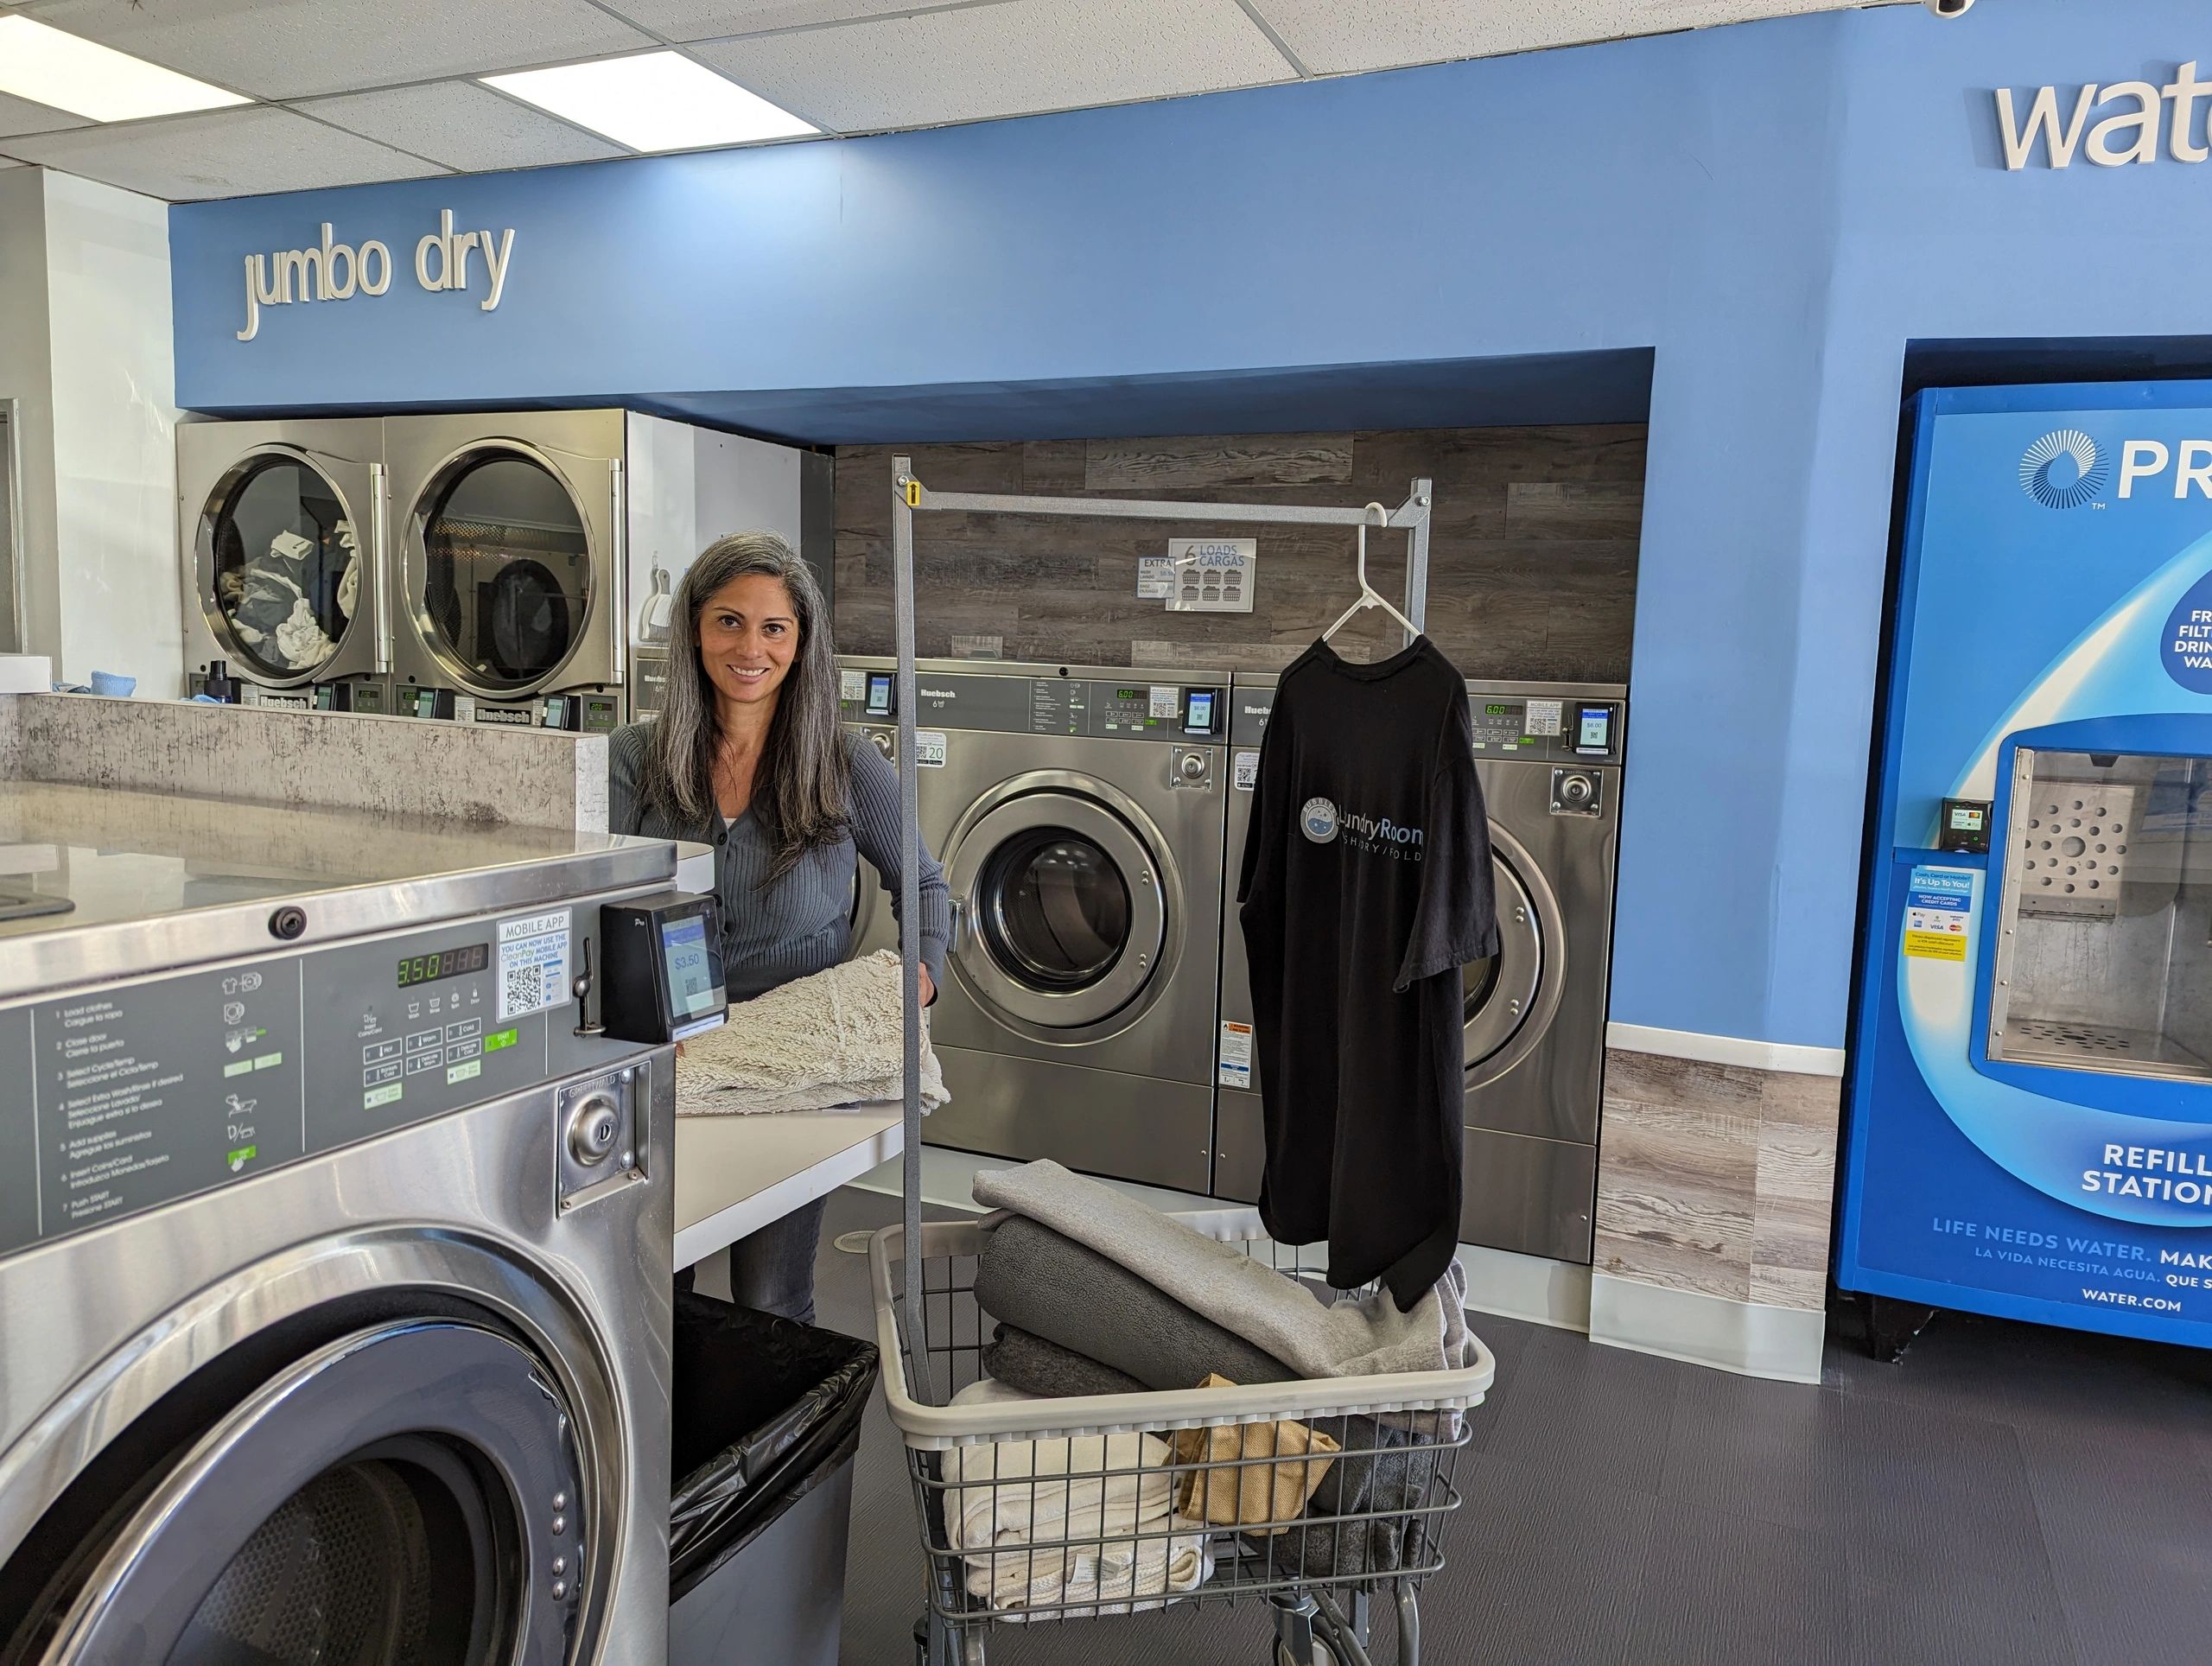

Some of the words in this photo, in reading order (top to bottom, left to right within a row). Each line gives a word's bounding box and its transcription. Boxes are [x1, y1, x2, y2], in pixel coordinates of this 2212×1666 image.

[1994, 60, 2212, 171] wat
[237, 222, 392, 340] jumbo
[415, 209, 515, 311] dry
[1144, 559, 1172, 568] EXTRA
[1185, 545, 1197, 566] 6
[1199, 545, 1237, 556] LOADS
[1199, 556, 1245, 566] CARGAS
[920, 689, 956, 698] Huebsch
[260, 696, 307, 709] Huebsch
[1486, 705, 1505, 715] 6.00
[476, 709, 531, 724] Huebsch
[929, 747, 944, 760] 20
[1928, 879, 1941, 887] Up
[505, 919, 543, 938] MOBILE
[545, 916, 565, 931] APP
[501, 945, 515, 954] YOU
[515, 942, 528, 951] CAN
[529, 938, 543, 948] NOW
[555, 933, 567, 942] THE
[536, 944, 556, 954] MOBILE
[556, 940, 568, 950] APP
[510, 960, 518, 969] ON
[519, 957, 533, 967] THIS
[534, 951, 559, 963] MACHINE
[674, 953, 699, 970] $3.50
[397, 954, 441, 985] 3.50
[463, 1024, 475, 1033] Cold
[1932, 1217, 1978, 1237] LIFE
[1984, 1225, 2059, 1250] NEEDS
[2066, 1237, 2152, 1263] WATER.
[1975, 1247, 1993, 1259] LA
[1996, 1251, 2033, 1265] VIDA
[2037, 1256, 2109, 1276] NECESITA
[2113, 1268, 2161, 1283] AGUA.
[2165, 1275, 2199, 1288] QUE
[2082, 1288, 2182, 1313] WATER.COM
